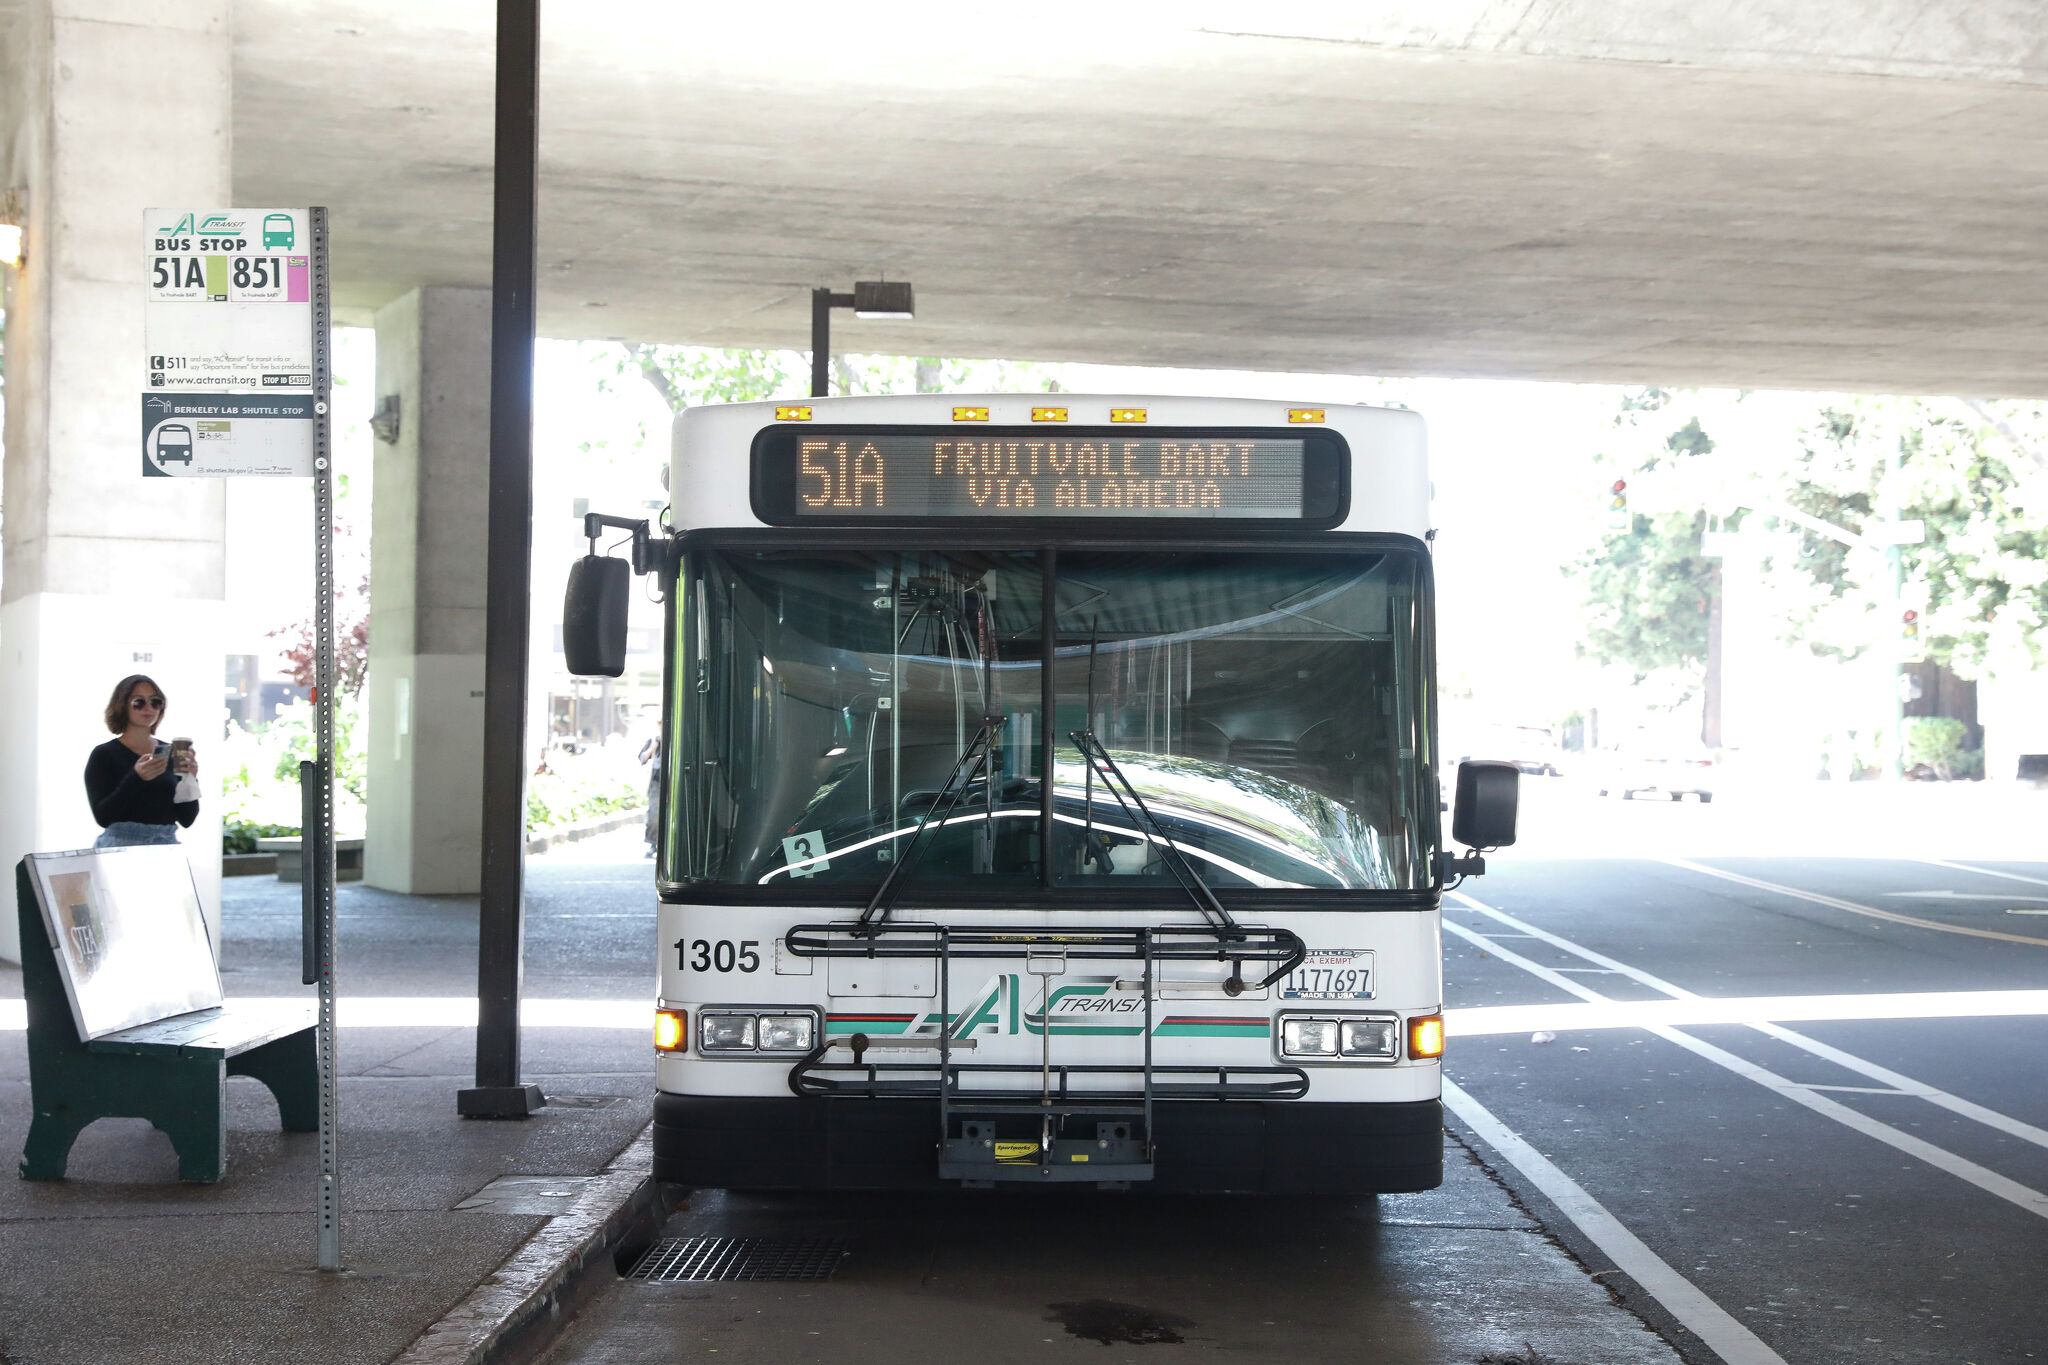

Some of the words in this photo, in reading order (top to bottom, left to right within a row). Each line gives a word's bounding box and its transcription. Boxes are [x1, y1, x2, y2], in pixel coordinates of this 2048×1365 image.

[155, 238, 191, 251] BUS
[199, 238, 247, 251] STOP
[153, 257, 205, 289] 51A
[233, 257, 280, 289] 851
[167, 357, 187, 369] 511
[166, 375, 257, 387] www.actransit.org
[263, 376, 280, 384] STOP
[174, 406, 219, 414] BERKELEY
[242, 407, 279, 415] SHUTTLE
[282, 407, 304, 415] STOP
[802, 442, 884, 508] 51A
[934, 442, 1141, 477] FRUITVALE
[1159, 443, 1256, 477] BART
[968, 479, 1036, 508] VIA
[1055, 479, 1222, 508] ALAMEDA
[793, 837, 816, 871] 3
[674, 938, 760, 973] 1305
[1303, 957, 1315, 965] CA
[1319, 957, 1353, 965] EXEMPT
[1286, 968, 1370, 992] 1177697
